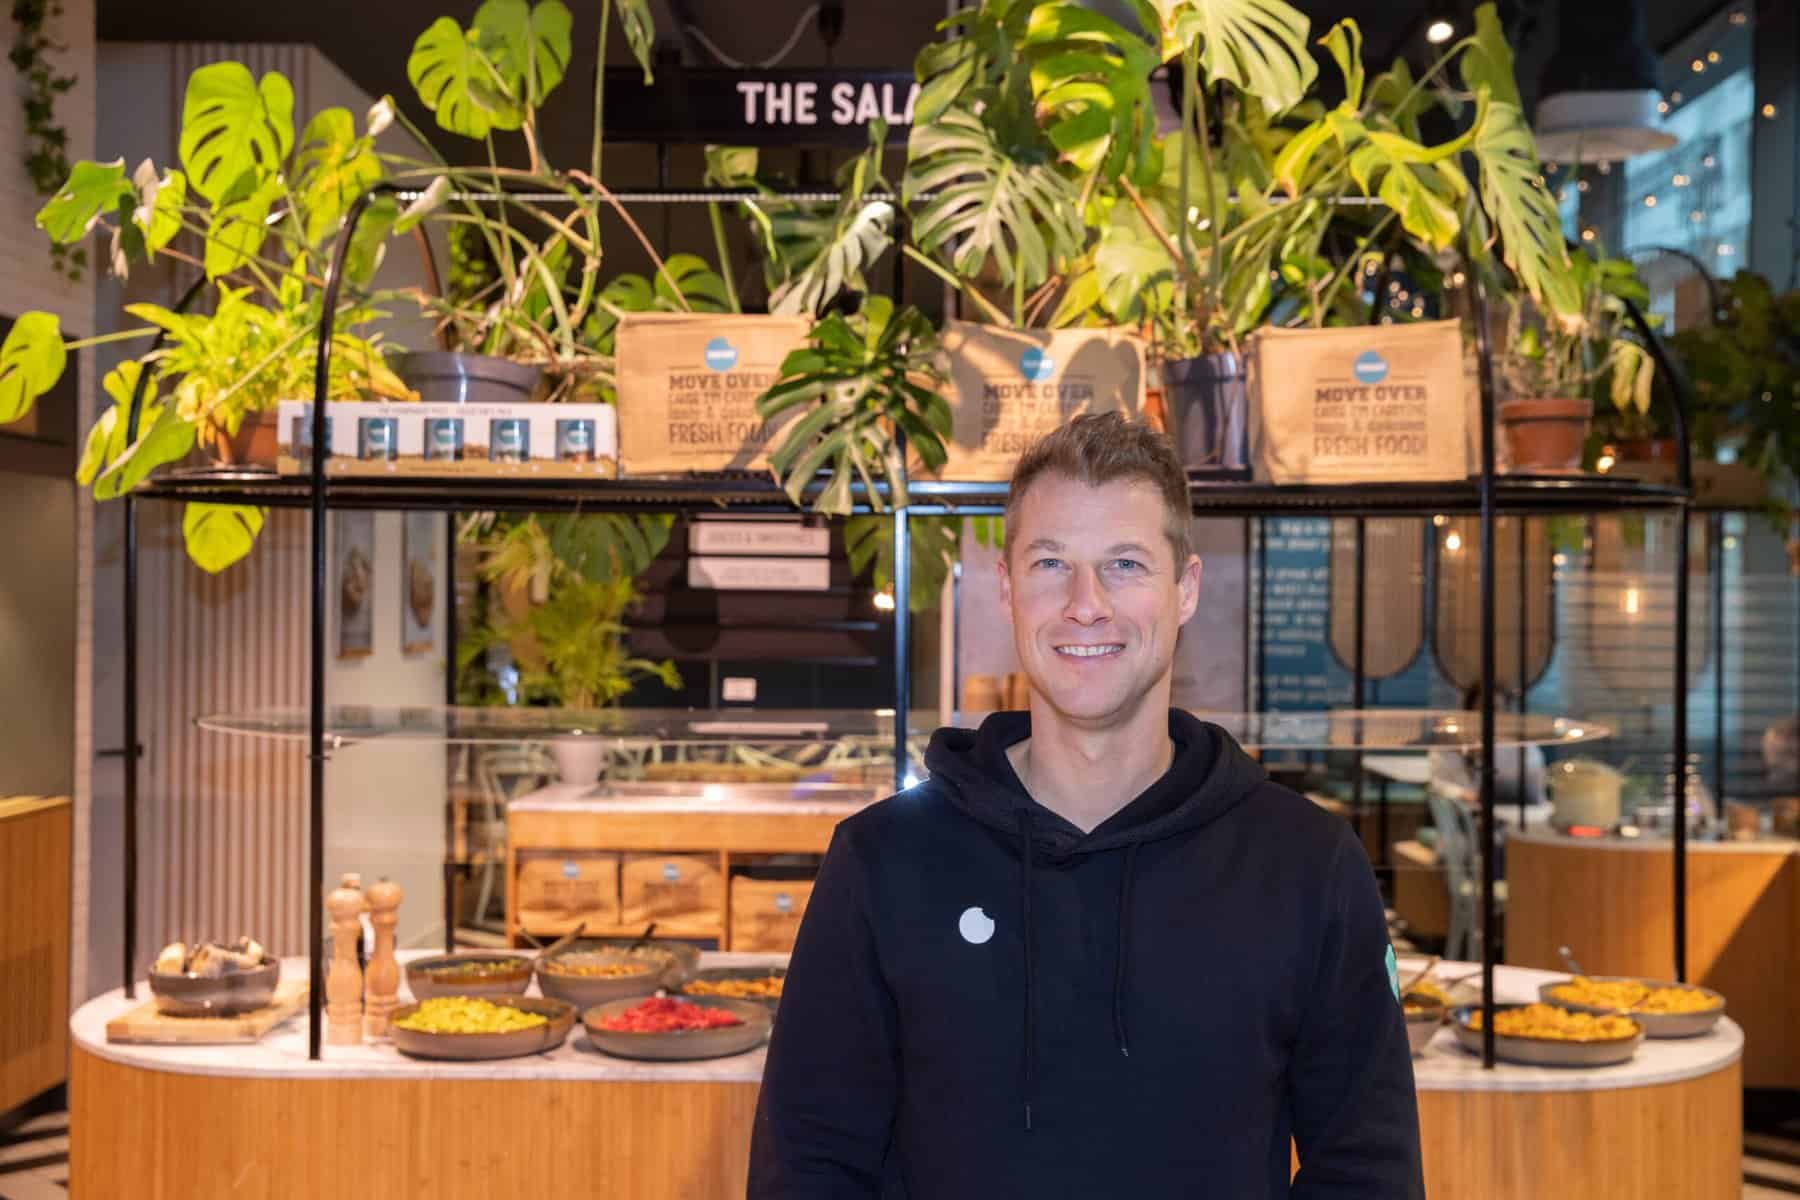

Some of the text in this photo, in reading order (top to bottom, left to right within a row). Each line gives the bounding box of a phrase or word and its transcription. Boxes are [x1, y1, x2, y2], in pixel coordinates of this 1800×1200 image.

[736, 82, 818, 125] THE
[669, 374, 721, 391] MOVE
[983, 384, 1036, 400] MOVE
[1315, 384, 1427, 402] MOVE OVER
[669, 422, 722, 444] FRESH
[1313, 434, 1369, 457] FRESH
